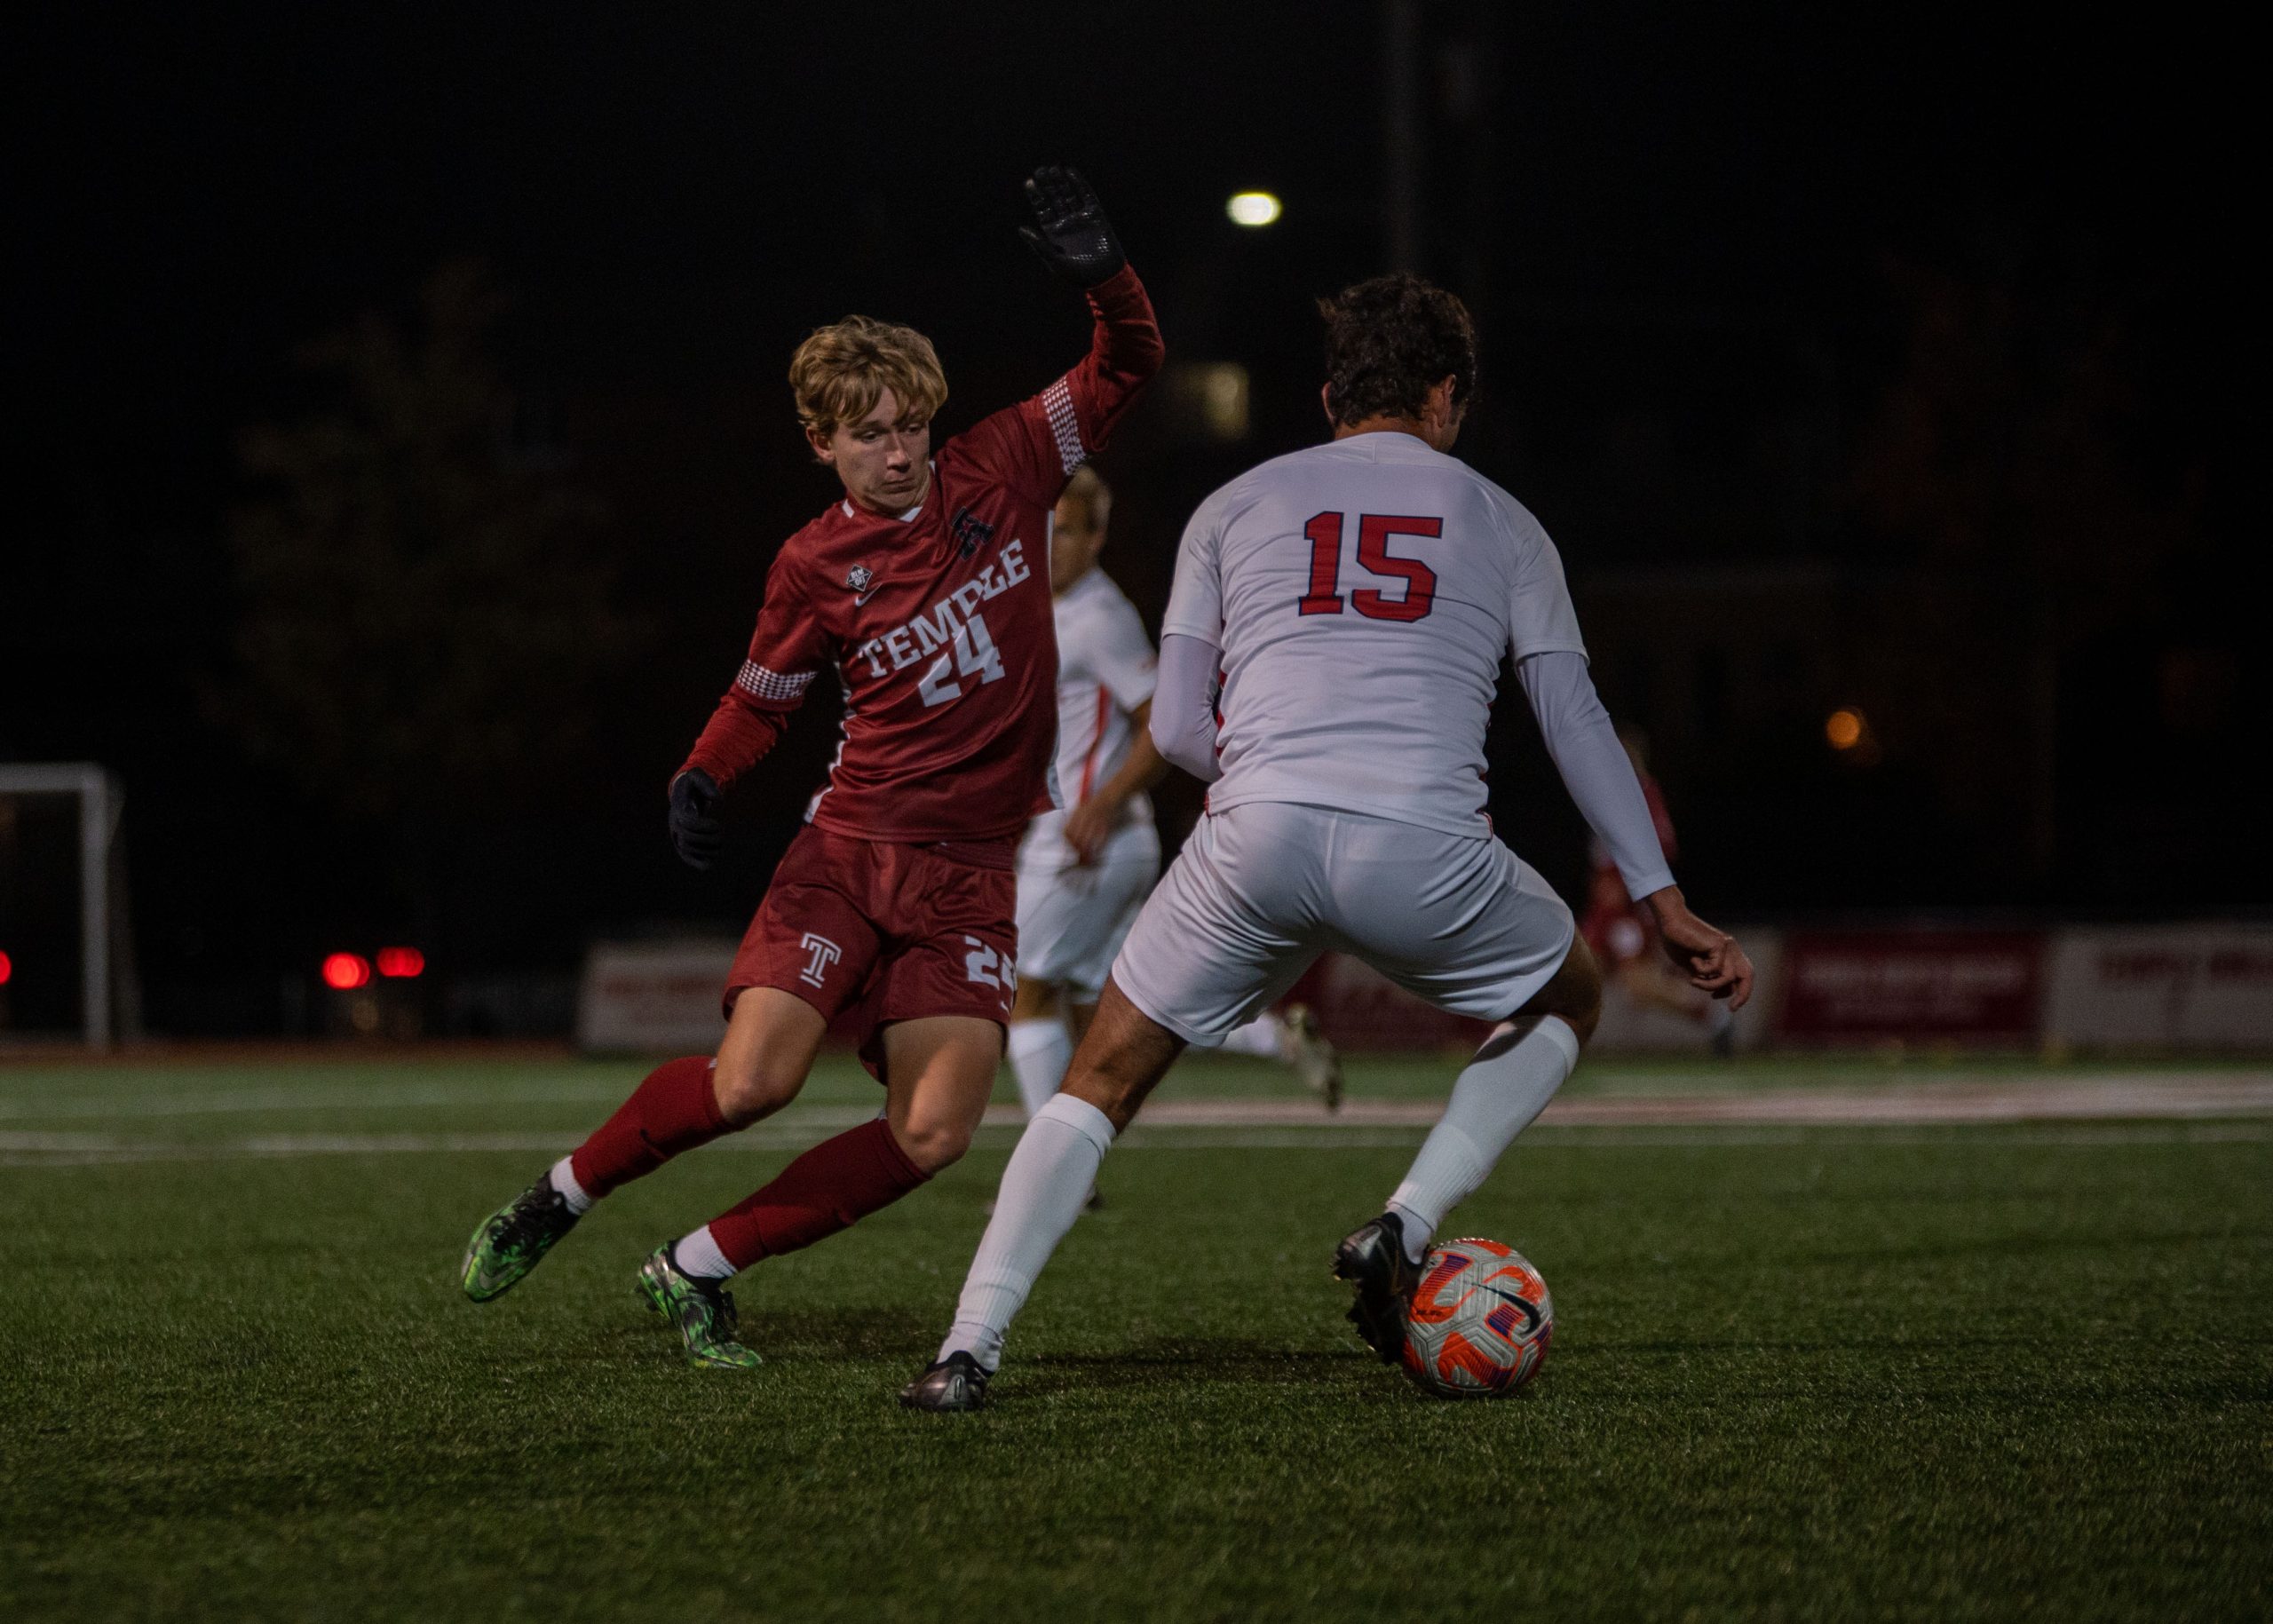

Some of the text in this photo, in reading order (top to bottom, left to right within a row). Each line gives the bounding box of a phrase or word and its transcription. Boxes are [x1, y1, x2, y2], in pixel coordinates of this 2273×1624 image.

[857, 538, 1031, 678] TEMPLE
[1298, 511, 1443, 623] 15
[918, 614, 1005, 708] 24
[800, 931, 843, 990] T
